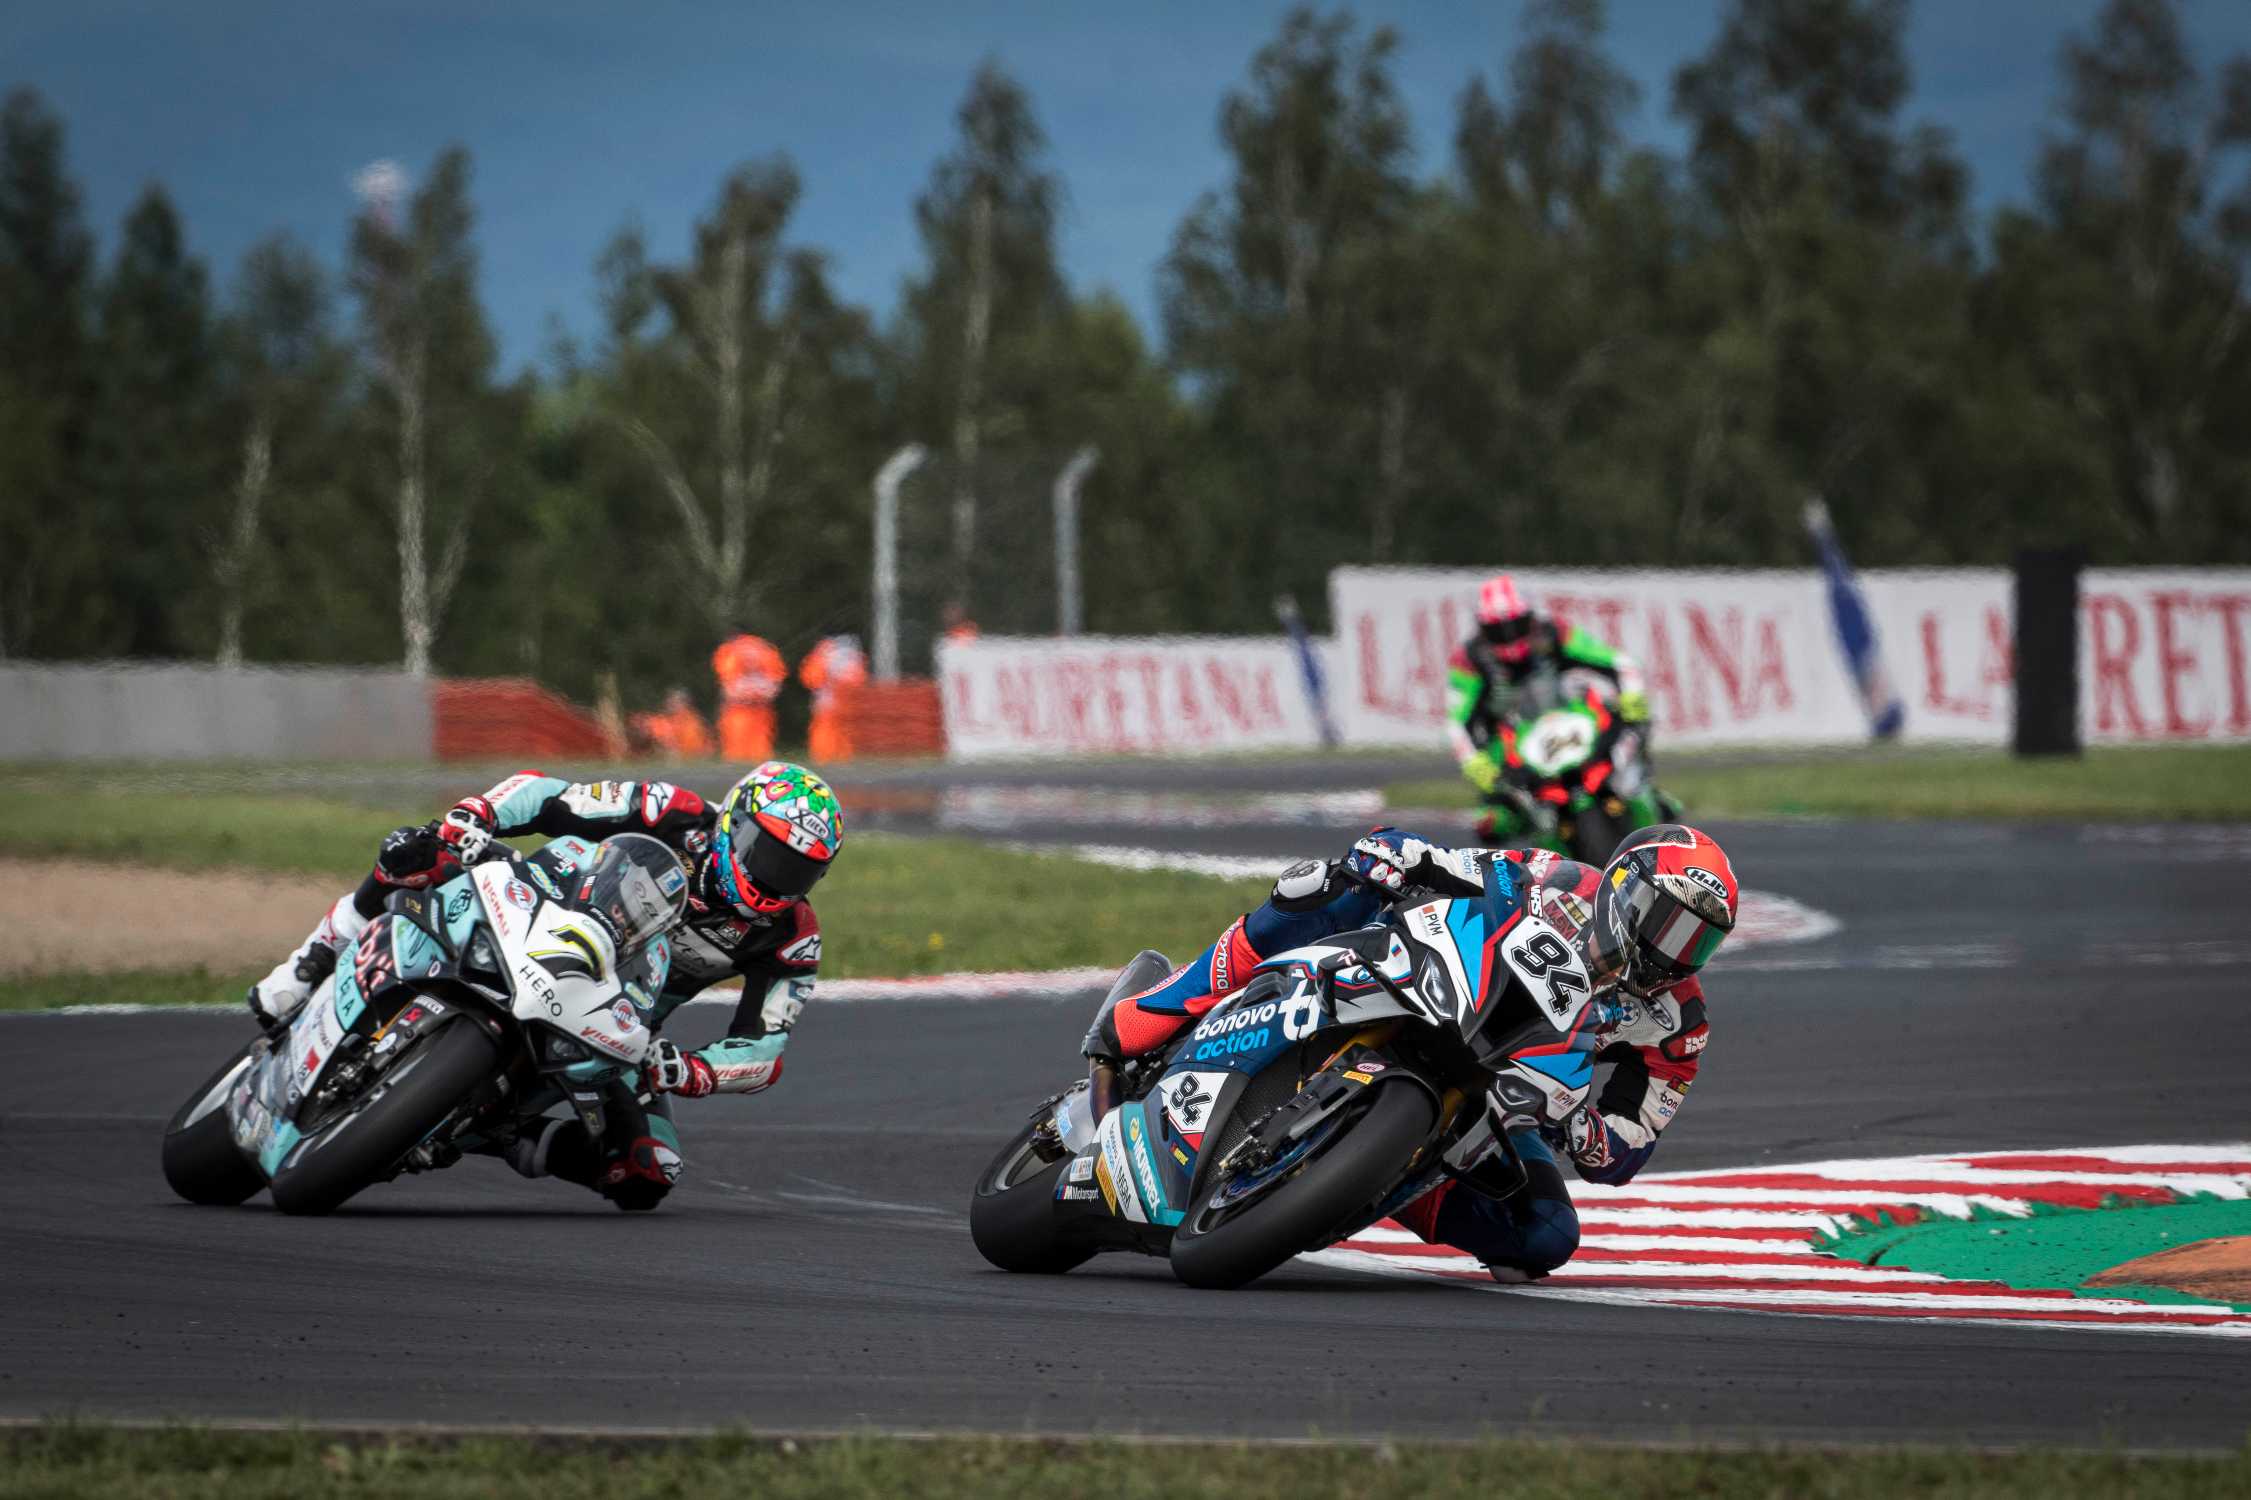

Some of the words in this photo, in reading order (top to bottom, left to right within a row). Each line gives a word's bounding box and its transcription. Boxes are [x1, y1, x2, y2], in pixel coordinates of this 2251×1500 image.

[1357, 597, 1793, 733] LATANA
[1921, 591, 2251, 738] LARET
[1687, 869, 1727, 896] HJC
[1425, 913, 1444, 936] PVM
[519, 965, 563, 1017] HERO
[1511, 931, 1588, 1016] 94
[1194, 1002, 1277, 1041] bonovo
[1195, 1028, 1270, 1061] action
[1169, 1072, 1213, 1126] 94
[1660, 1090, 1678, 1110] bon
[1073, 1185, 1099, 1203] Motorsport
